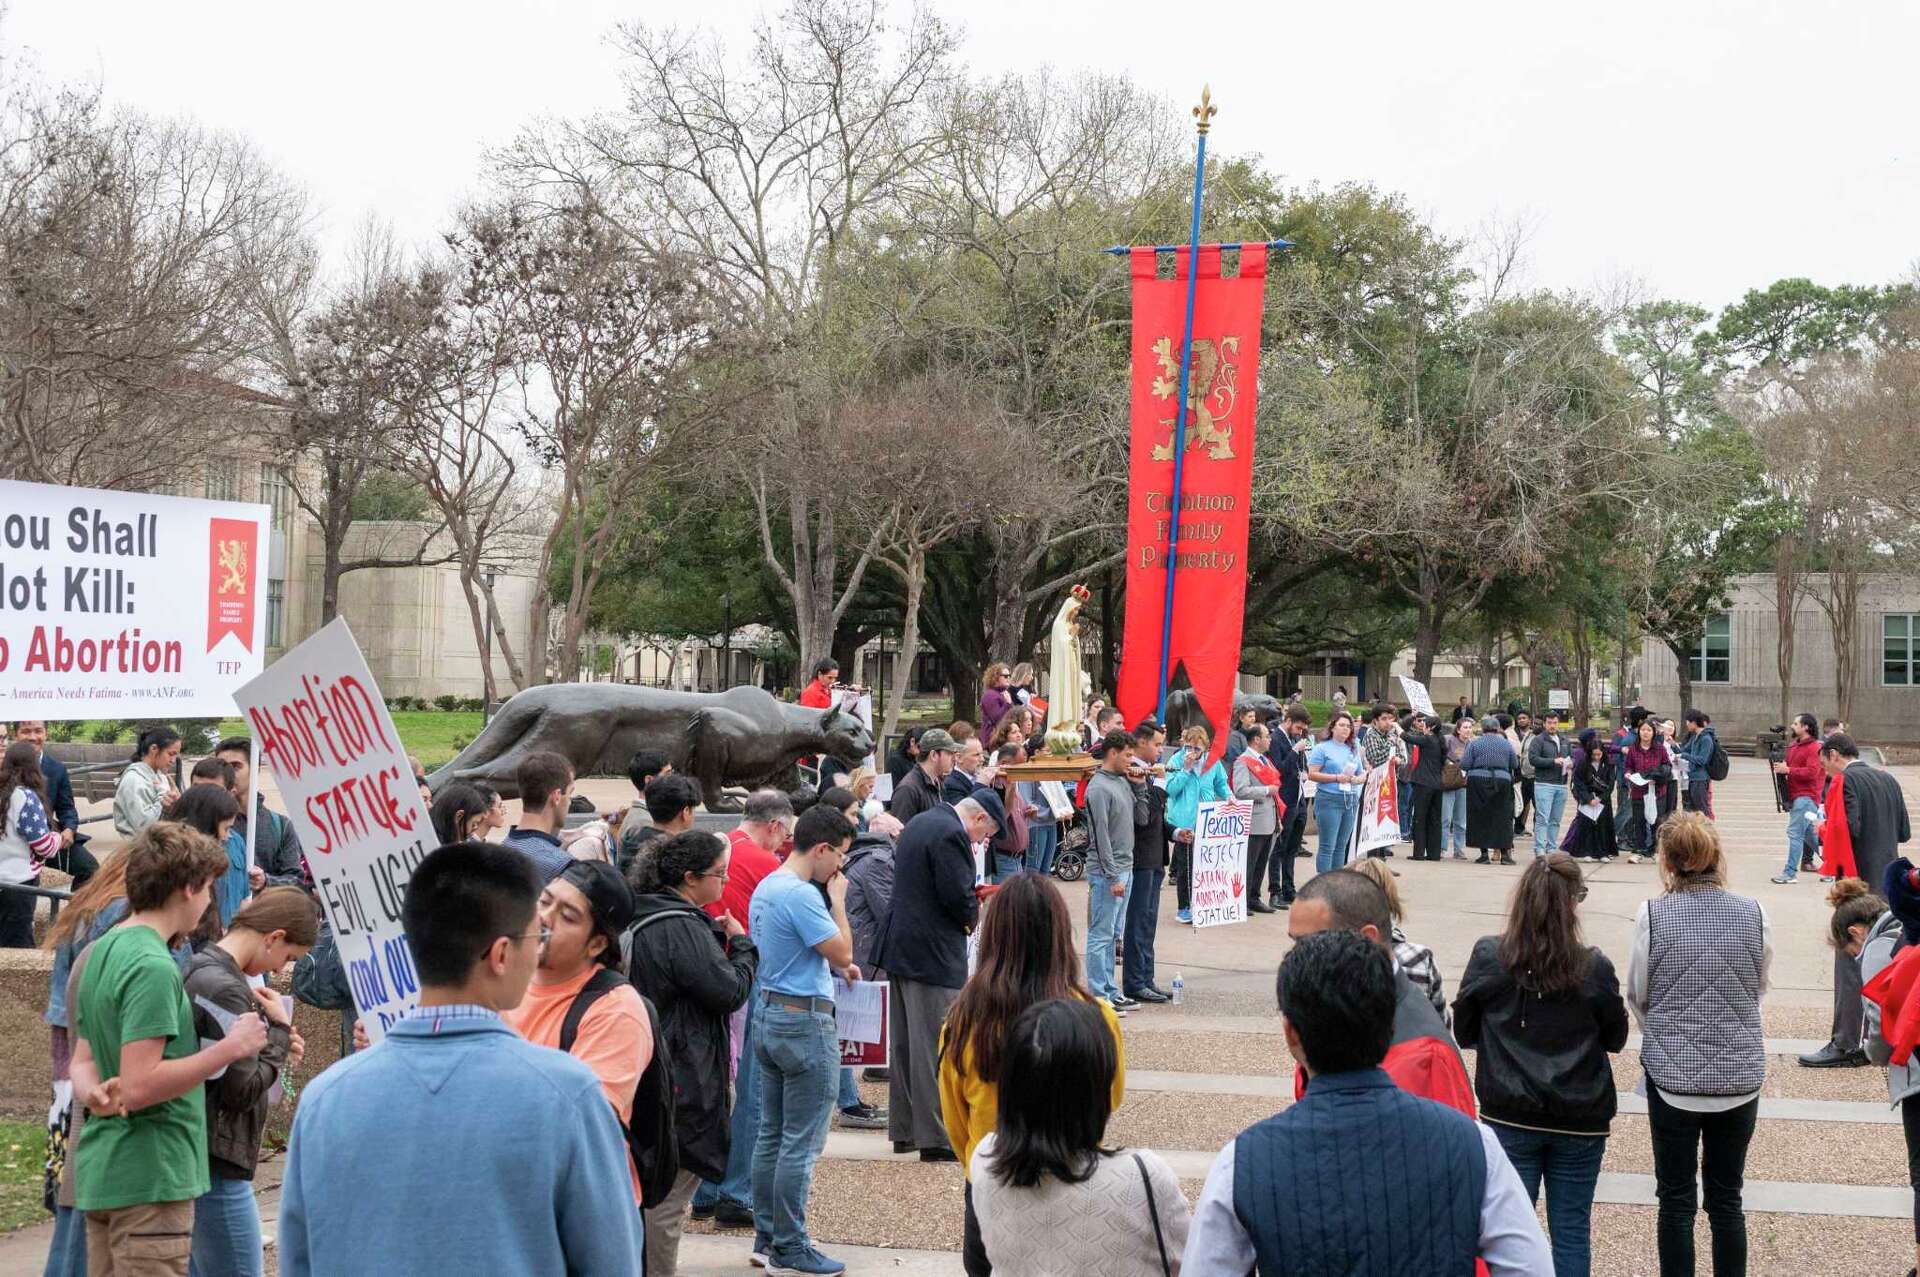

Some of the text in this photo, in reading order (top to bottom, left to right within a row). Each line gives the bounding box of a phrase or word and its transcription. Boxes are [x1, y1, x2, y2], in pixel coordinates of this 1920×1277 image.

[0, 506, 157, 557] ou Shall
[0, 562, 135, 614] ot Kill:
[24, 626, 182, 673] Abortion
[217, 661, 242, 675] TFP
[10, 687, 53, 700] America
[56, 687, 85, 699] Needs
[88, 687, 122, 699] Fatima
[249, 674, 394, 779] Abortion
[1201, 808, 1244, 839] Texans
[1201, 841, 1245, 869] REJECT
[1198, 904, 1241, 926] STATUE!
